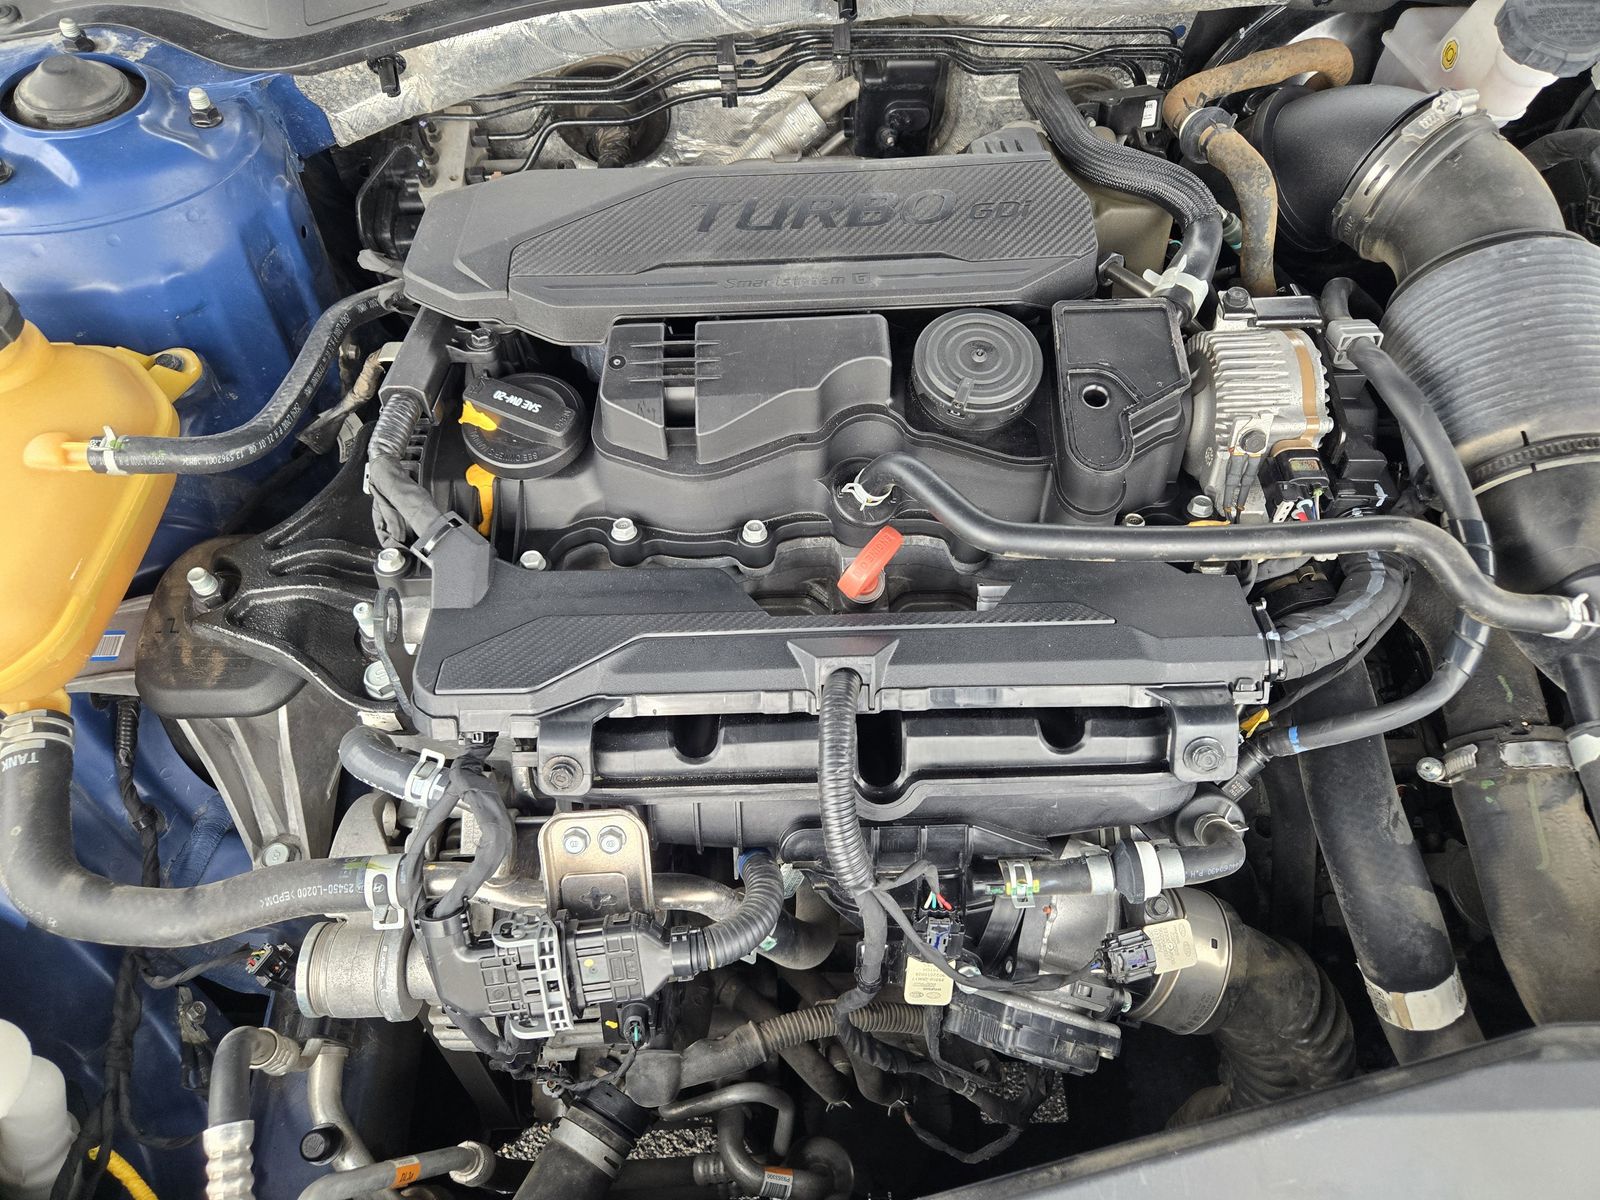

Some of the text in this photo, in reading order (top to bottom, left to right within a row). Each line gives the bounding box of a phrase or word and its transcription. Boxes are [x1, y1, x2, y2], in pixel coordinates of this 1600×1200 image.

[692, 188, 1032, 233] TURBO GDi
[723, 275, 846, 290] Smartstream
[493, 390, 542, 413] SAE 0W-20
[523, 452, 538, 462] SEE
[1, 752, 39, 772] TANK
[297, 883, 354, 898] 25450-L0200
